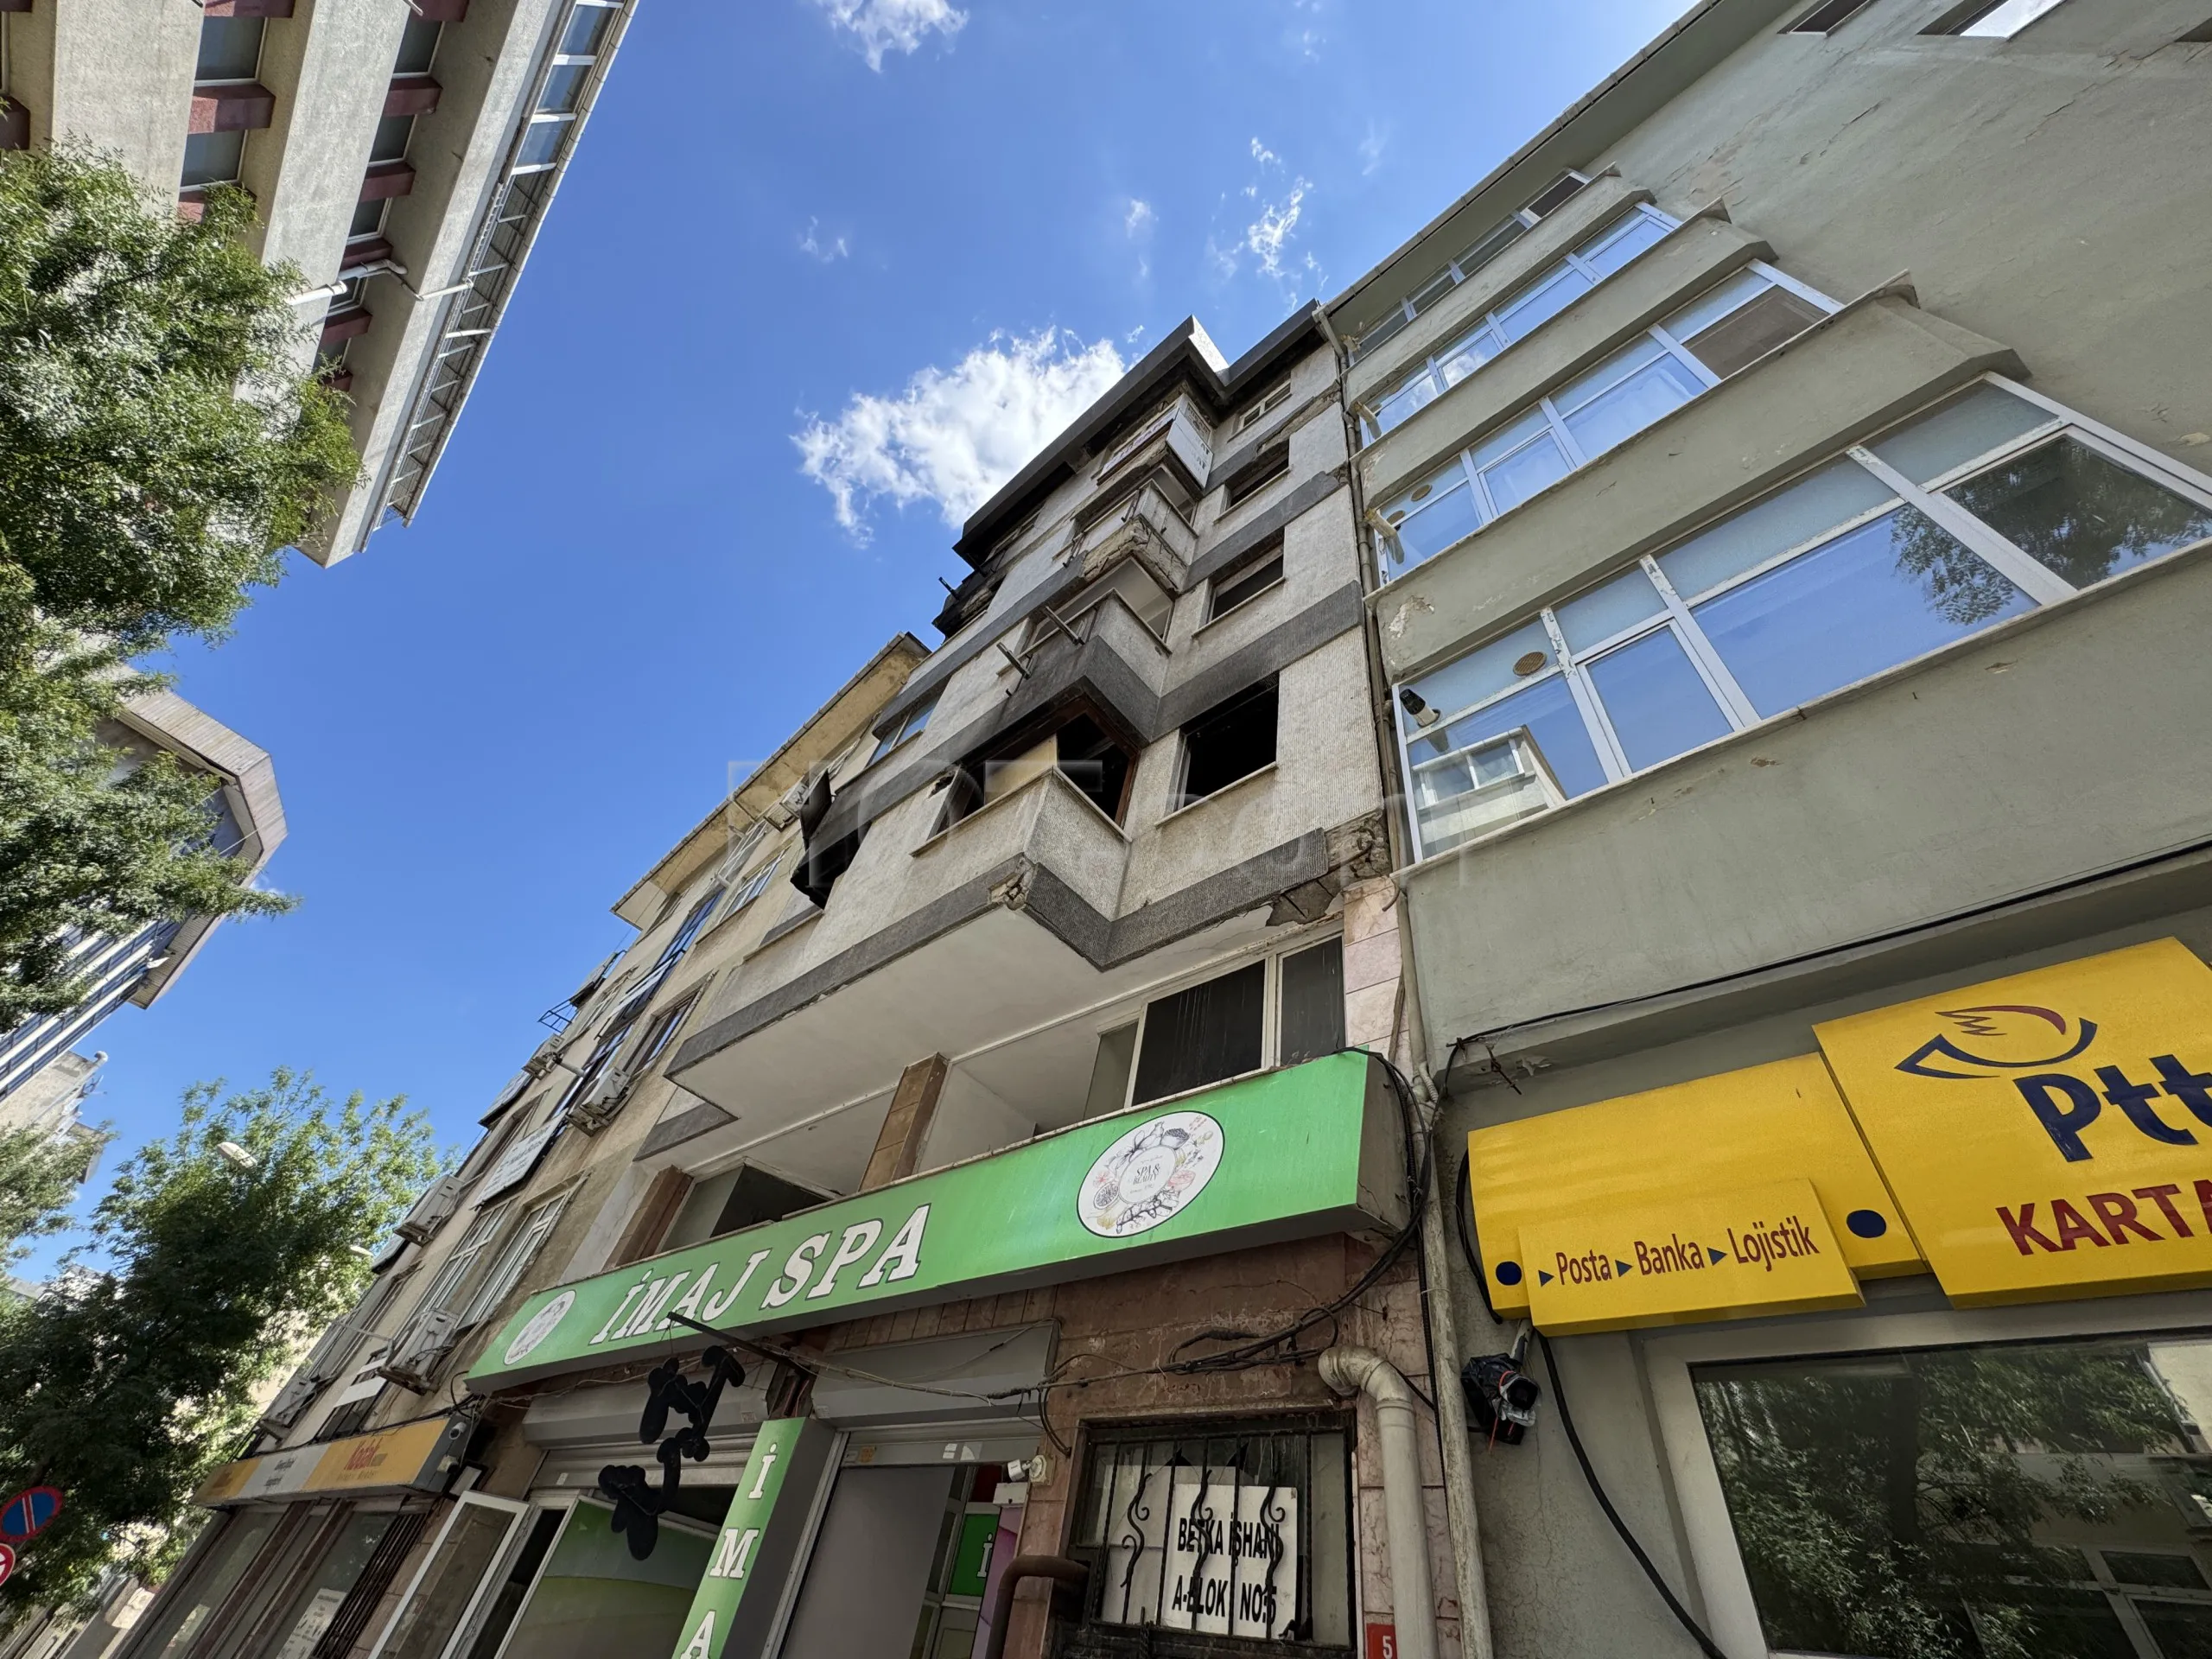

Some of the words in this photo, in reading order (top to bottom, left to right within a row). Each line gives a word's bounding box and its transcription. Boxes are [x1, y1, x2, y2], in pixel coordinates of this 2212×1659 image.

[2012, 1054, 2212, 1162] Ptt
[588, 1248, 772, 1345] İMAJ
[760, 1203, 931, 1310] SPA
[1556, 1249, 1612, 1285] Posta
[1634, 1234, 1705, 1275] Banka
[1727, 1216, 1820, 1271] Lojistik
[1382, 1635, 1393, 1659] 5
